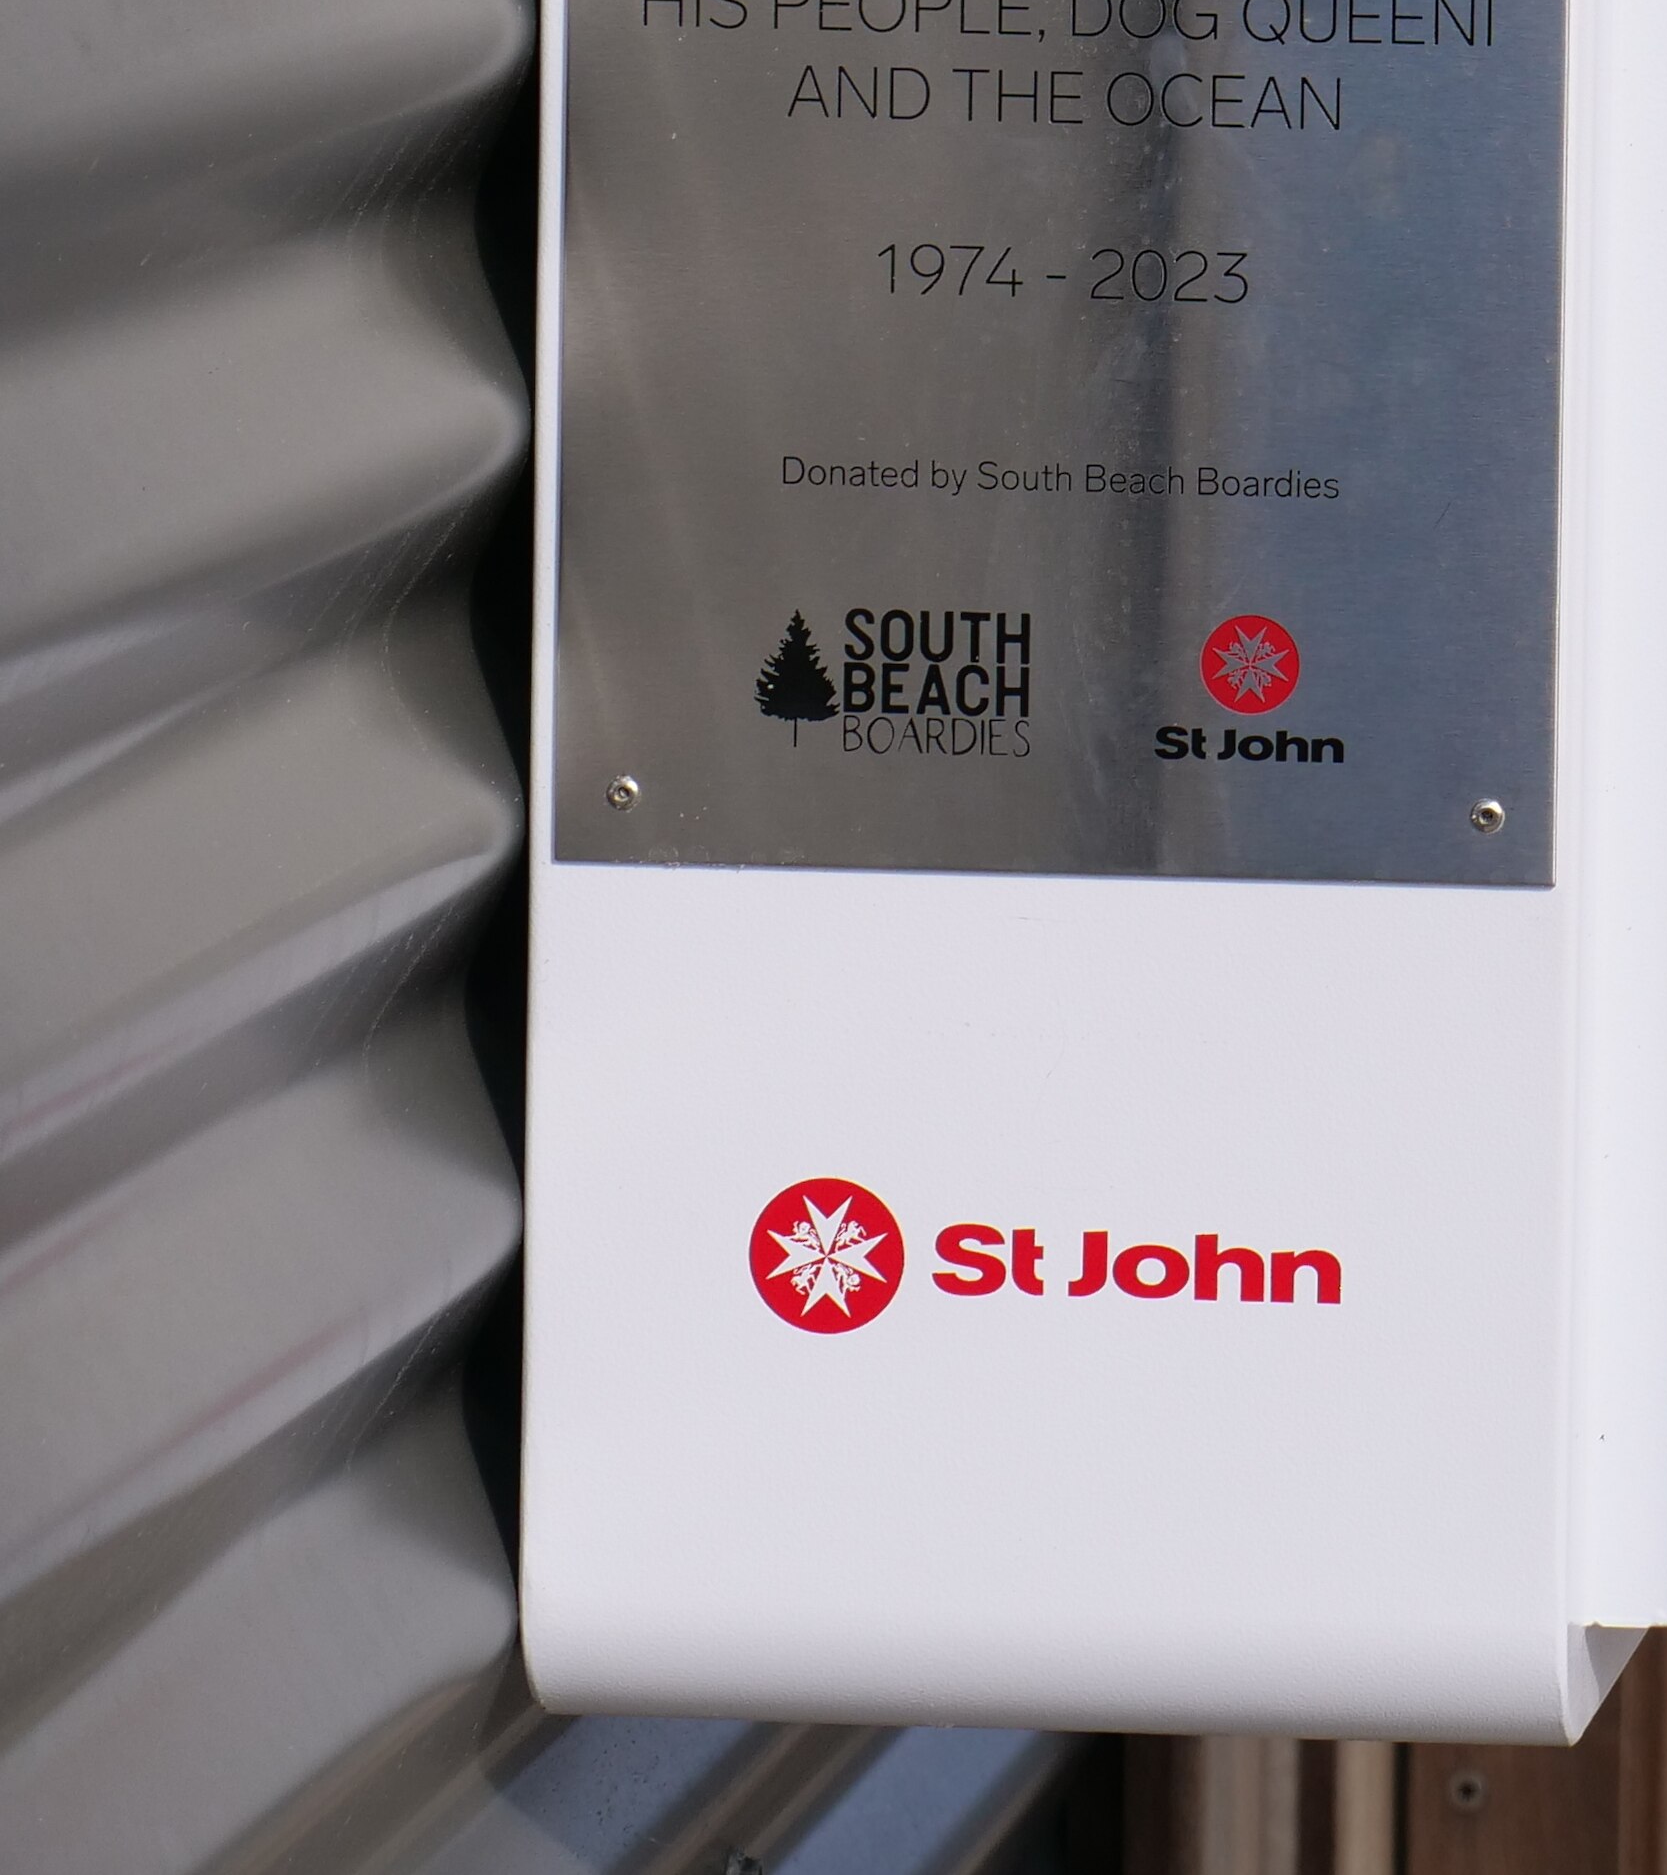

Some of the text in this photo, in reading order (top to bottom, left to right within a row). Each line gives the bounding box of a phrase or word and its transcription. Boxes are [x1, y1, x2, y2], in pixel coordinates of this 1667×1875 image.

[788, 64, 1342, 130] AND THE OCEAN
[877, 243, 1024, 297] 1974
[1089, 249, 1251, 304] 2023
[781, 456, 1340, 499] Donated by South Beach Boardies
[844, 607, 1030, 664] SOUTH
[843, 663, 1030, 717] BEACH
[843, 717, 1030, 758] BOARDIES
[1154, 726, 1344, 763] St John
[931, 1223, 1342, 1304] St John
